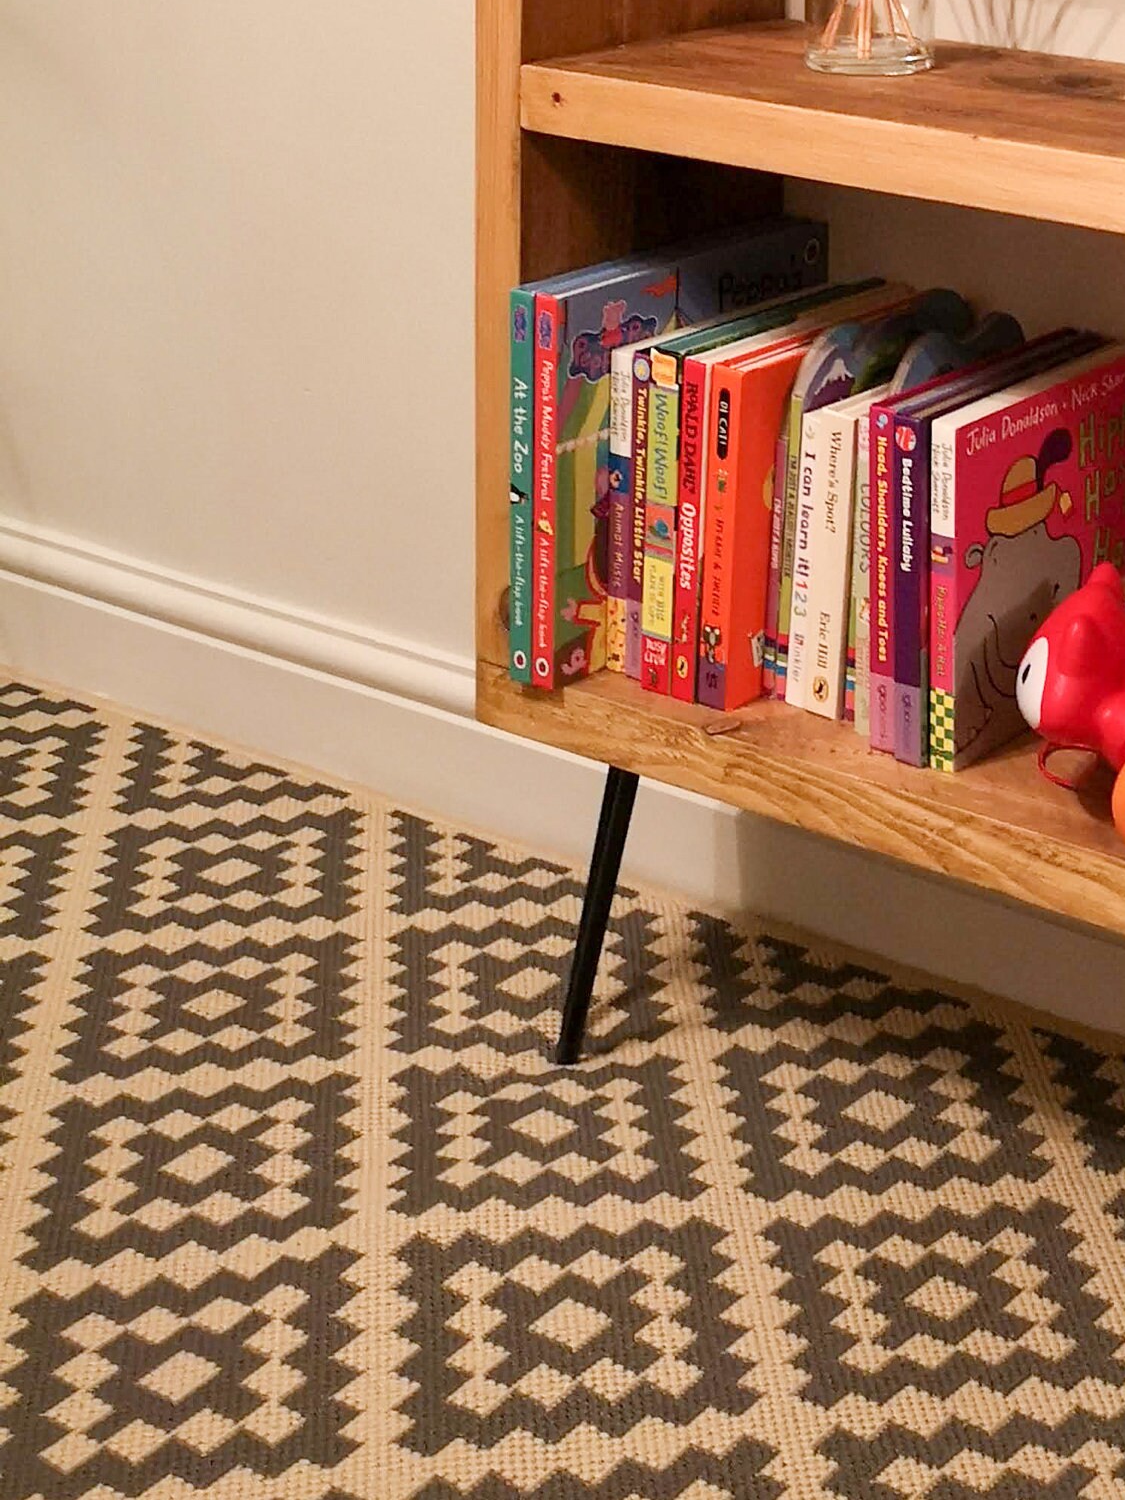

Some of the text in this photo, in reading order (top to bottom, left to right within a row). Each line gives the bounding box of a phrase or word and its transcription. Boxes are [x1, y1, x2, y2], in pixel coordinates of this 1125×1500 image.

[540, 360, 554, 402] Peppa's
[513, 377, 529, 474] At the Zoo
[540, 406, 553, 449] Muddy
[654, 393, 669, 446] Woof!
[684, 382, 700, 438] ROALD
[718, 418, 728, 445] CAT!
[966, 425, 996, 456] Julia
[1001, 403, 1059, 440] Donaldson
[1071, 383, 1098, 411] Nick
[540, 453, 553, 502] Festival
[652, 448, 668, 500] Woof!
[803, 466, 814, 497] can
[805, 452, 816, 461] I
[825, 430, 842, 533] Where's Spot?
[942, 443, 953, 520] Julia Donaldson
[632, 388, 648, 583] Twinkle, Twinkle, Little Star
[799, 503, 815, 551] learn
[900, 458, 914, 572] Bedtime Lullaby
[611, 502, 625, 587] Animal Music
[679, 502, 697, 591] Opposites
[796, 557, 809, 577] it!
[876, 436, 888, 662] Head, Shoulders, Knees and Toes
[795, 581, 809, 589] 1
[795, 591, 808, 602] 2
[794, 605, 807, 618] 3
[817, 611, 831, 669] Eric Hill
